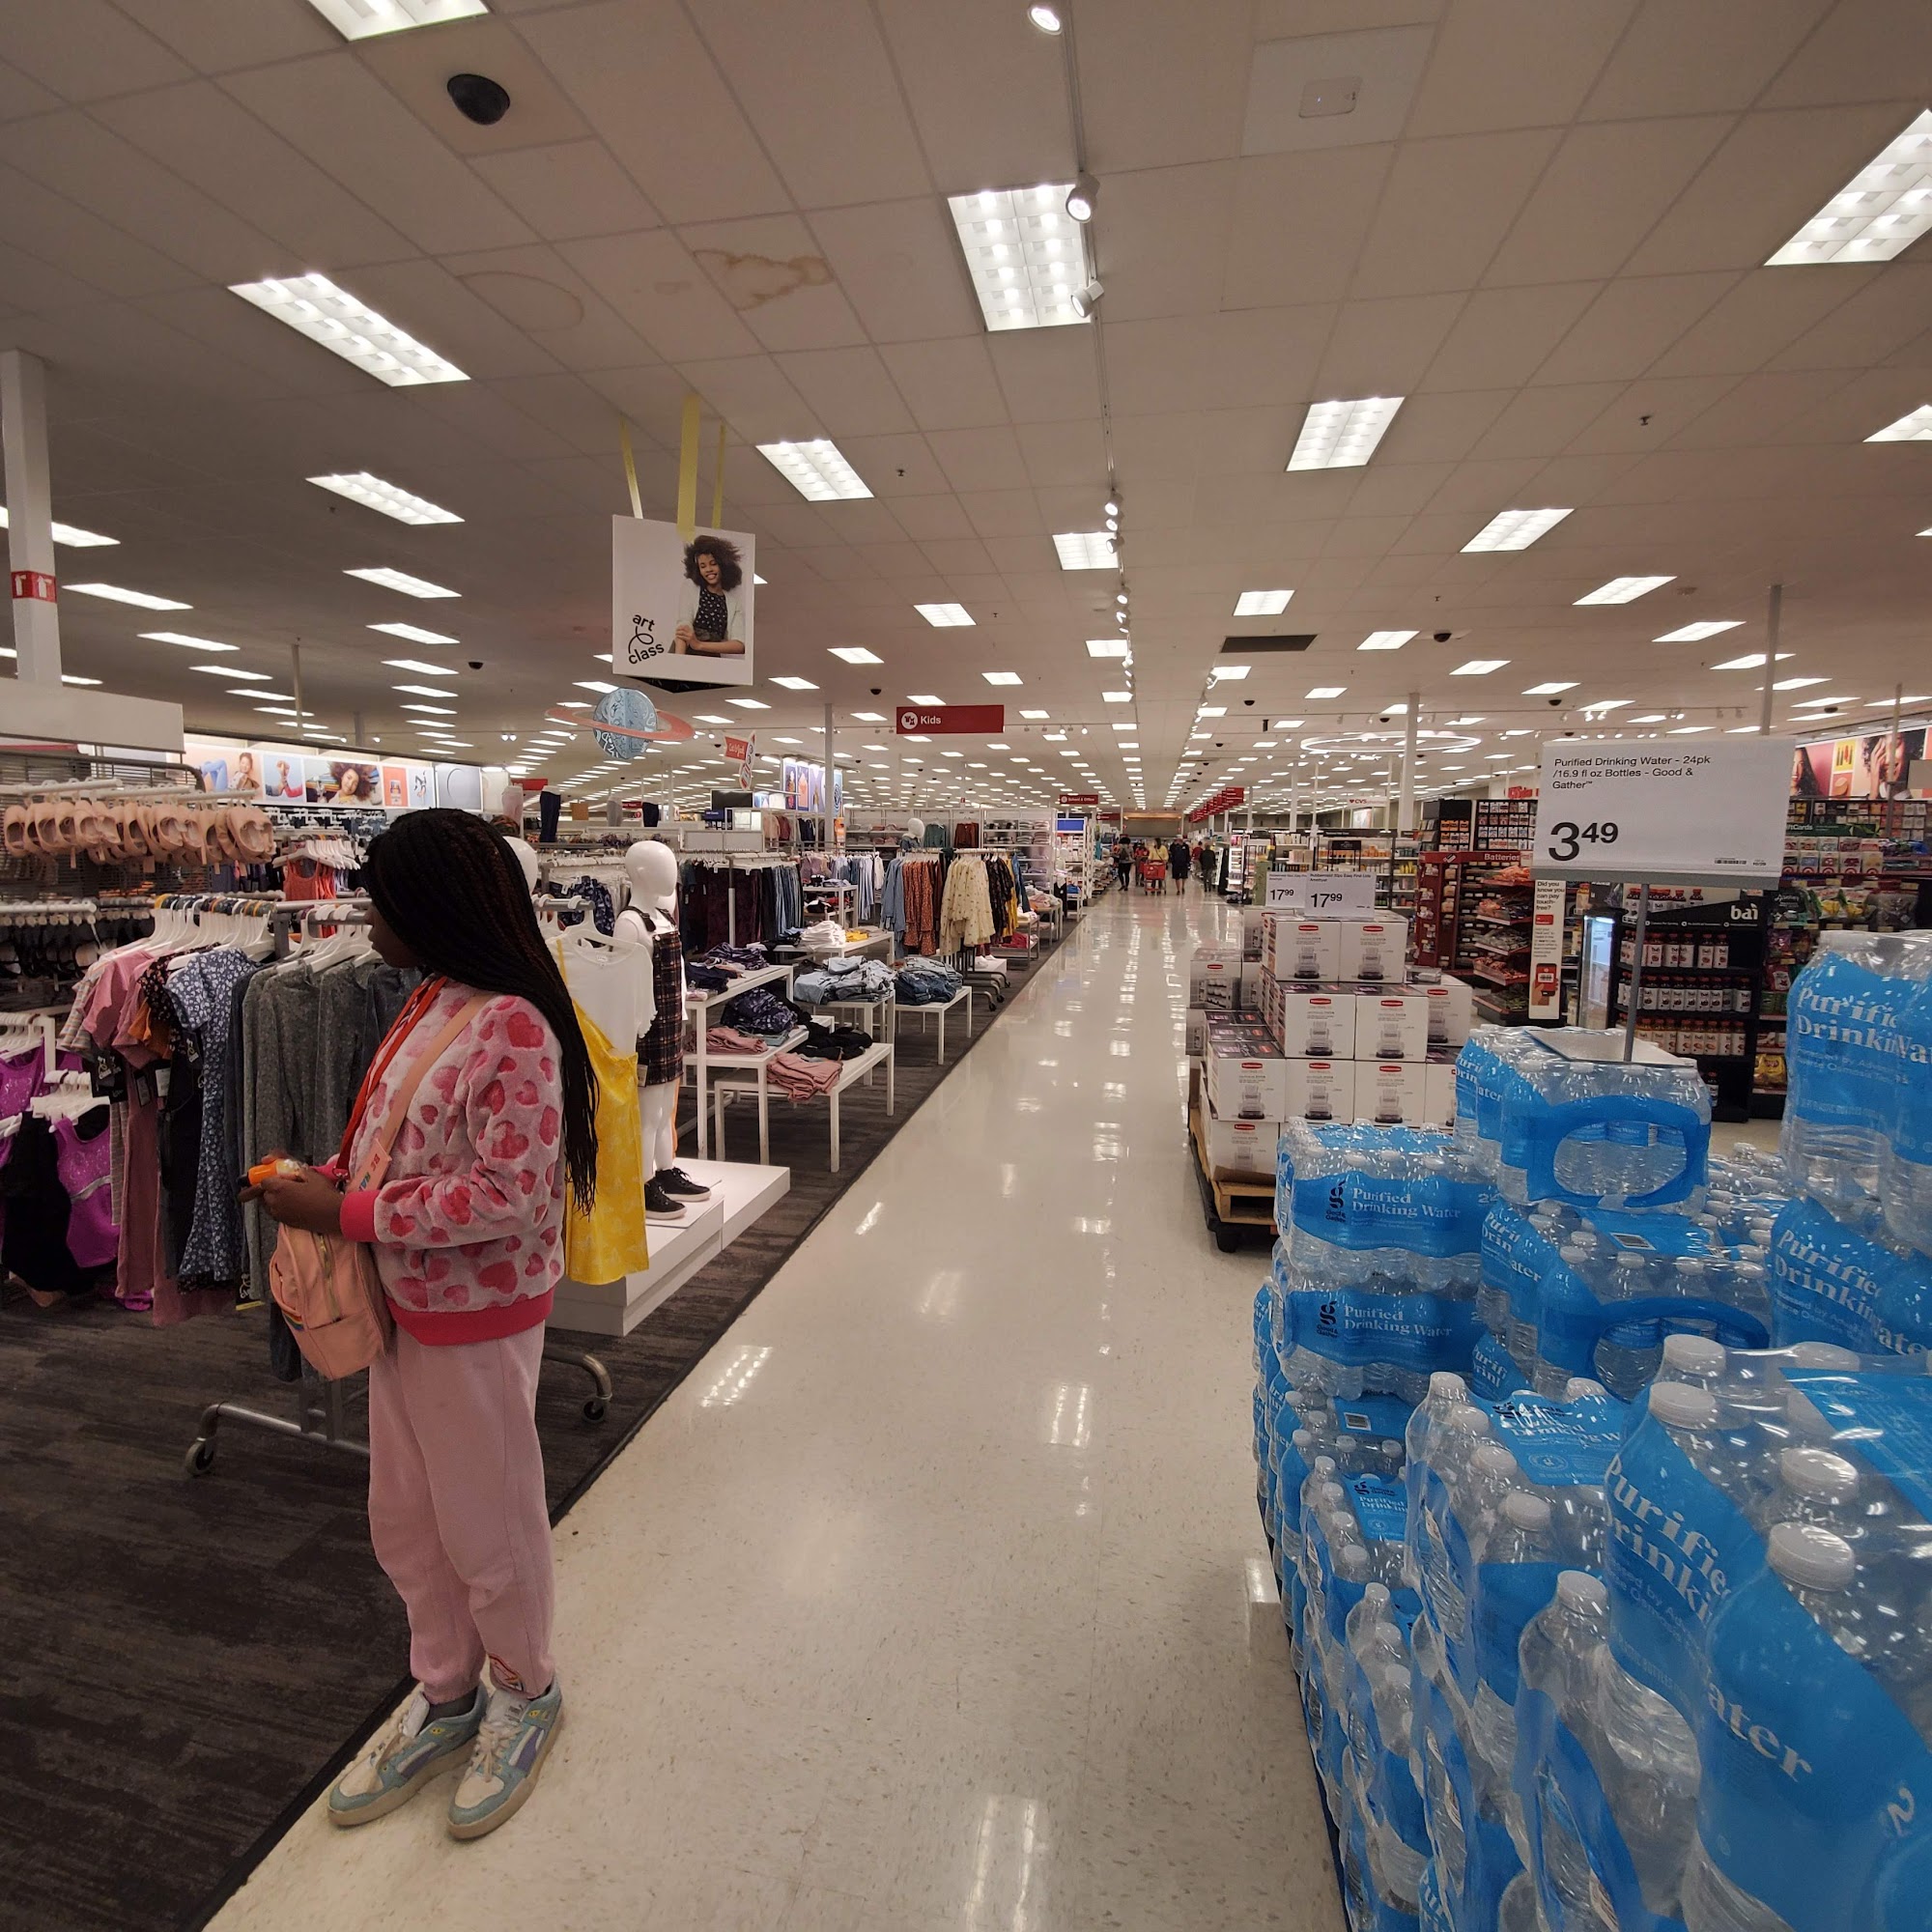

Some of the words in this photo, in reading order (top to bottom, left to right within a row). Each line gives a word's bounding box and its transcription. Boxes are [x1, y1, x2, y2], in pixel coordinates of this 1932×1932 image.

[633, 614, 655, 632] art
[629, 644, 665, 665] class
[921, 716, 942, 724] Kids
[1554, 757, 1592, 767] Purified
[1595, 757, 1636, 768] Drinking
[1640, 756, 1673, 765] Water
[1683, 755, 1712, 765] 24pk
[1552, 770, 1578, 779] /16.9
[1605, 769, 1641, 778] Bottles
[1652, 768, 1683, 777] Good
[1685, 768, 1693, 777] &
[1730, 903, 1758, 920] bai
[1478, 1087, 1503, 1101] ater
[1352, 1187, 1411, 1205] Purified
[1352, 1201, 1418, 1219] Drinking
[1421, 1204, 1461, 1218] Water
[1510, 1260, 1542, 1282] ater
[1344, 1303, 1404, 1321] Purified
[1344, 1319, 1410, 1335] Drinking
[1413, 1323, 1453, 1338] Water
[1361, 1502, 1407, 1512] Drinkin
[1605, 1498, 1714, 1627] rinki
[1708, 1682, 1813, 1783] ater
